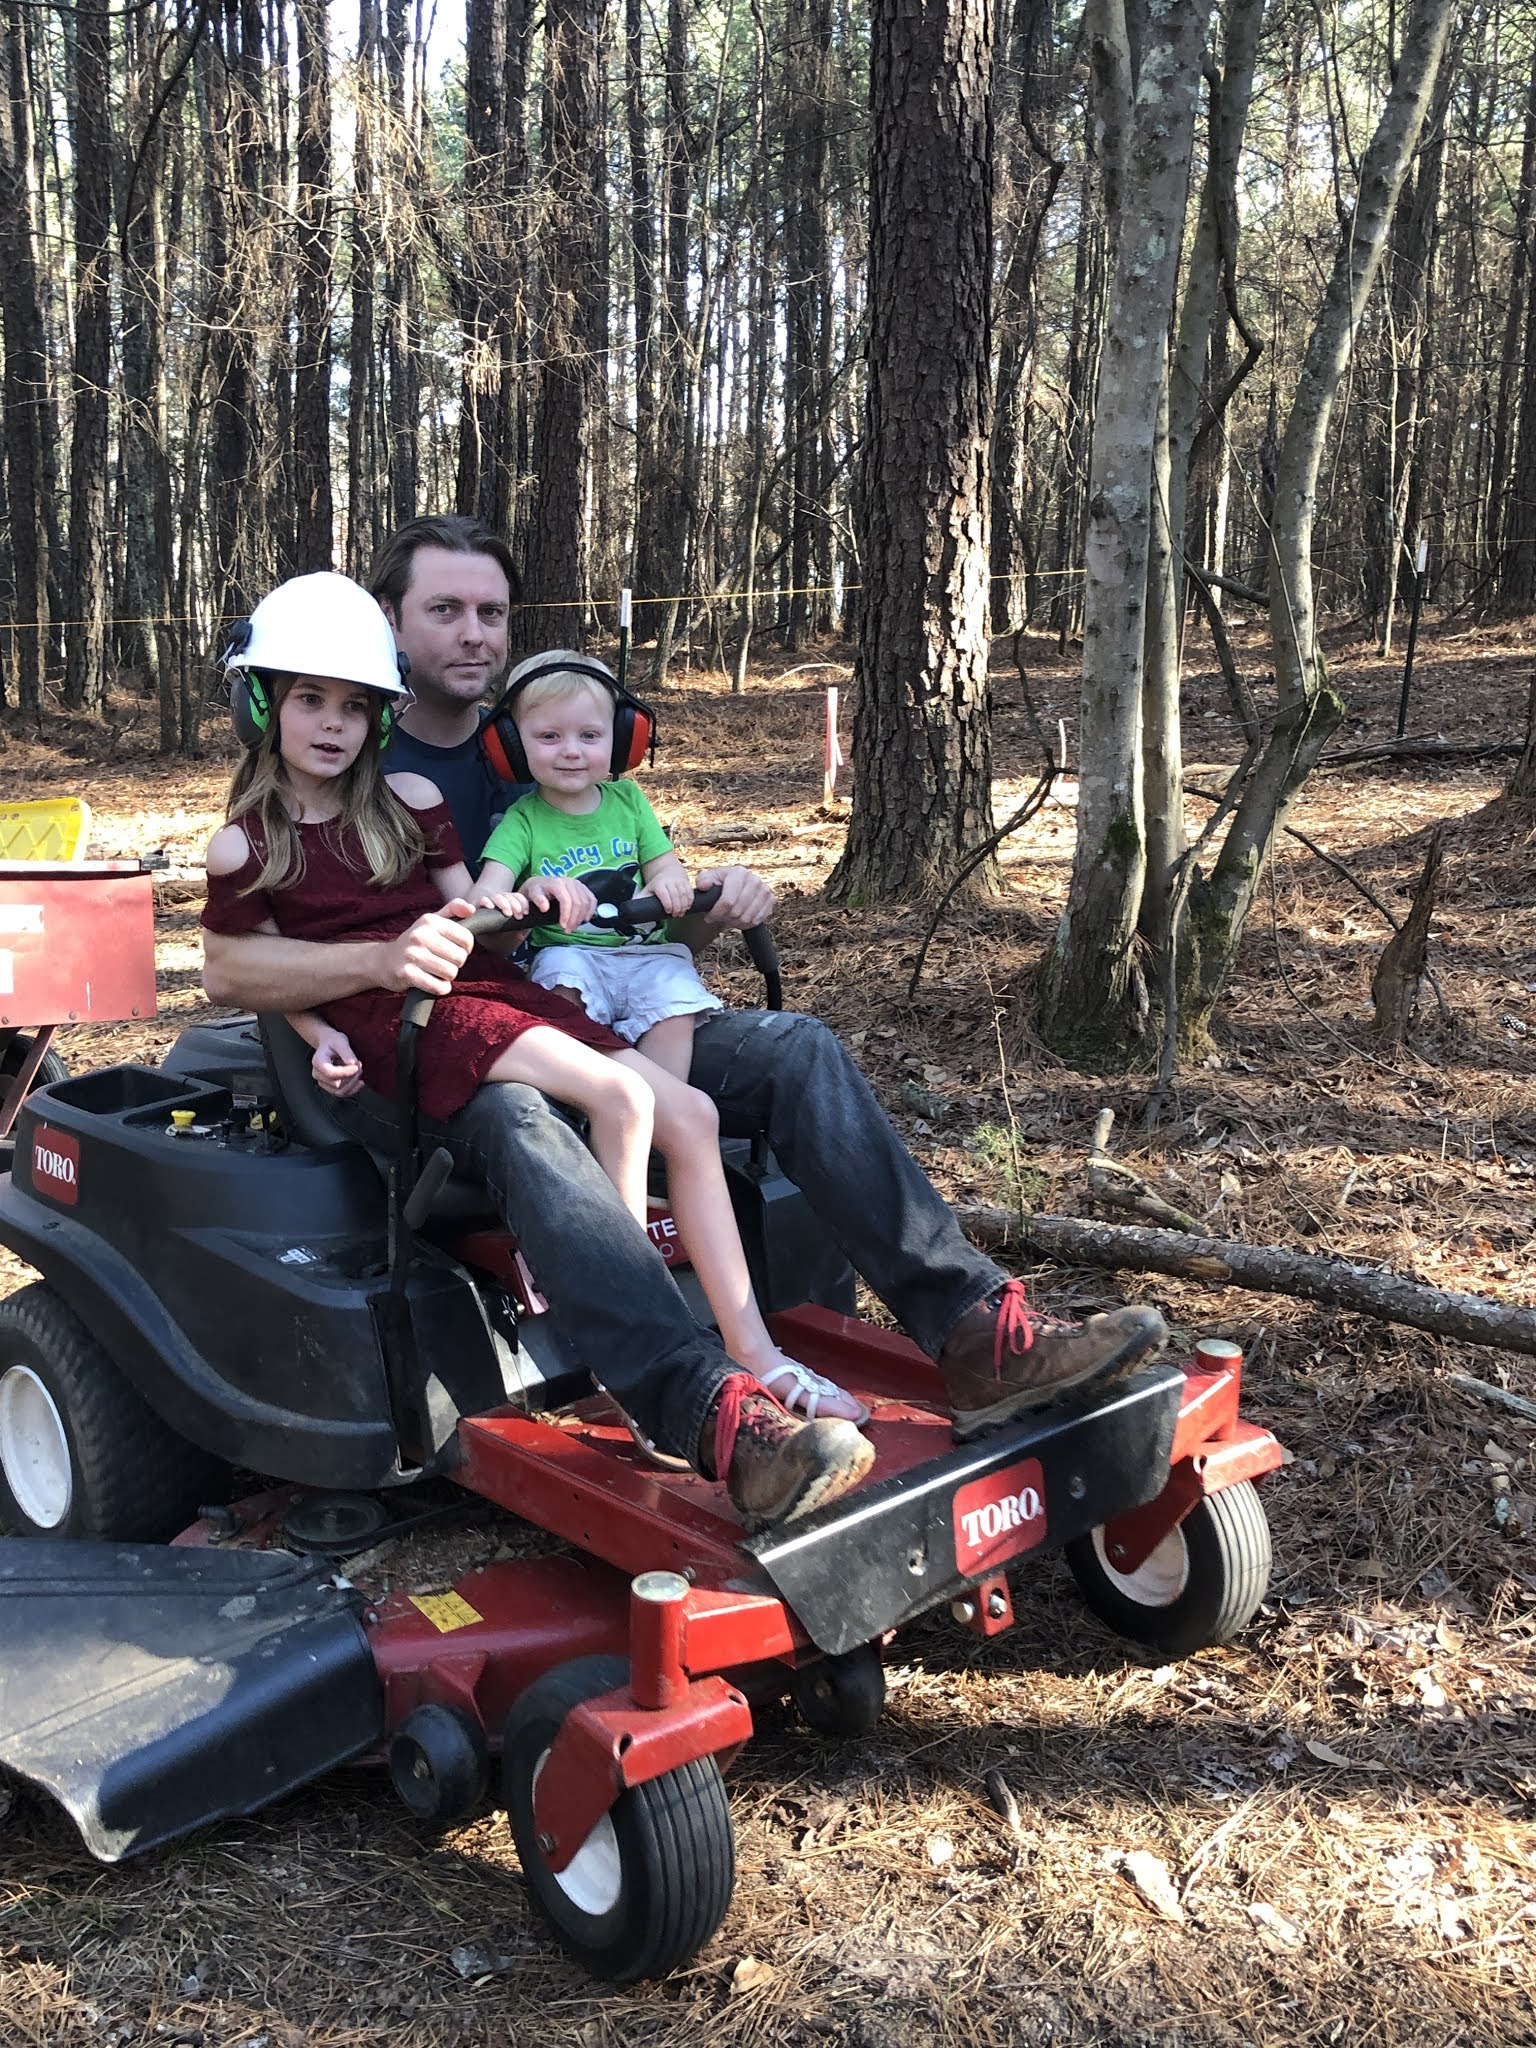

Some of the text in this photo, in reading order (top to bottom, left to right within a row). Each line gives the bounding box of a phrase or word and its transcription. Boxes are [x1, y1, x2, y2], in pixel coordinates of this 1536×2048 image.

[610, 836, 638, 858] Cu
[35, 1145, 75, 1183] TORO
[646, 1217, 678, 1240] TE
[961, 1487, 1040, 1548] TORO
